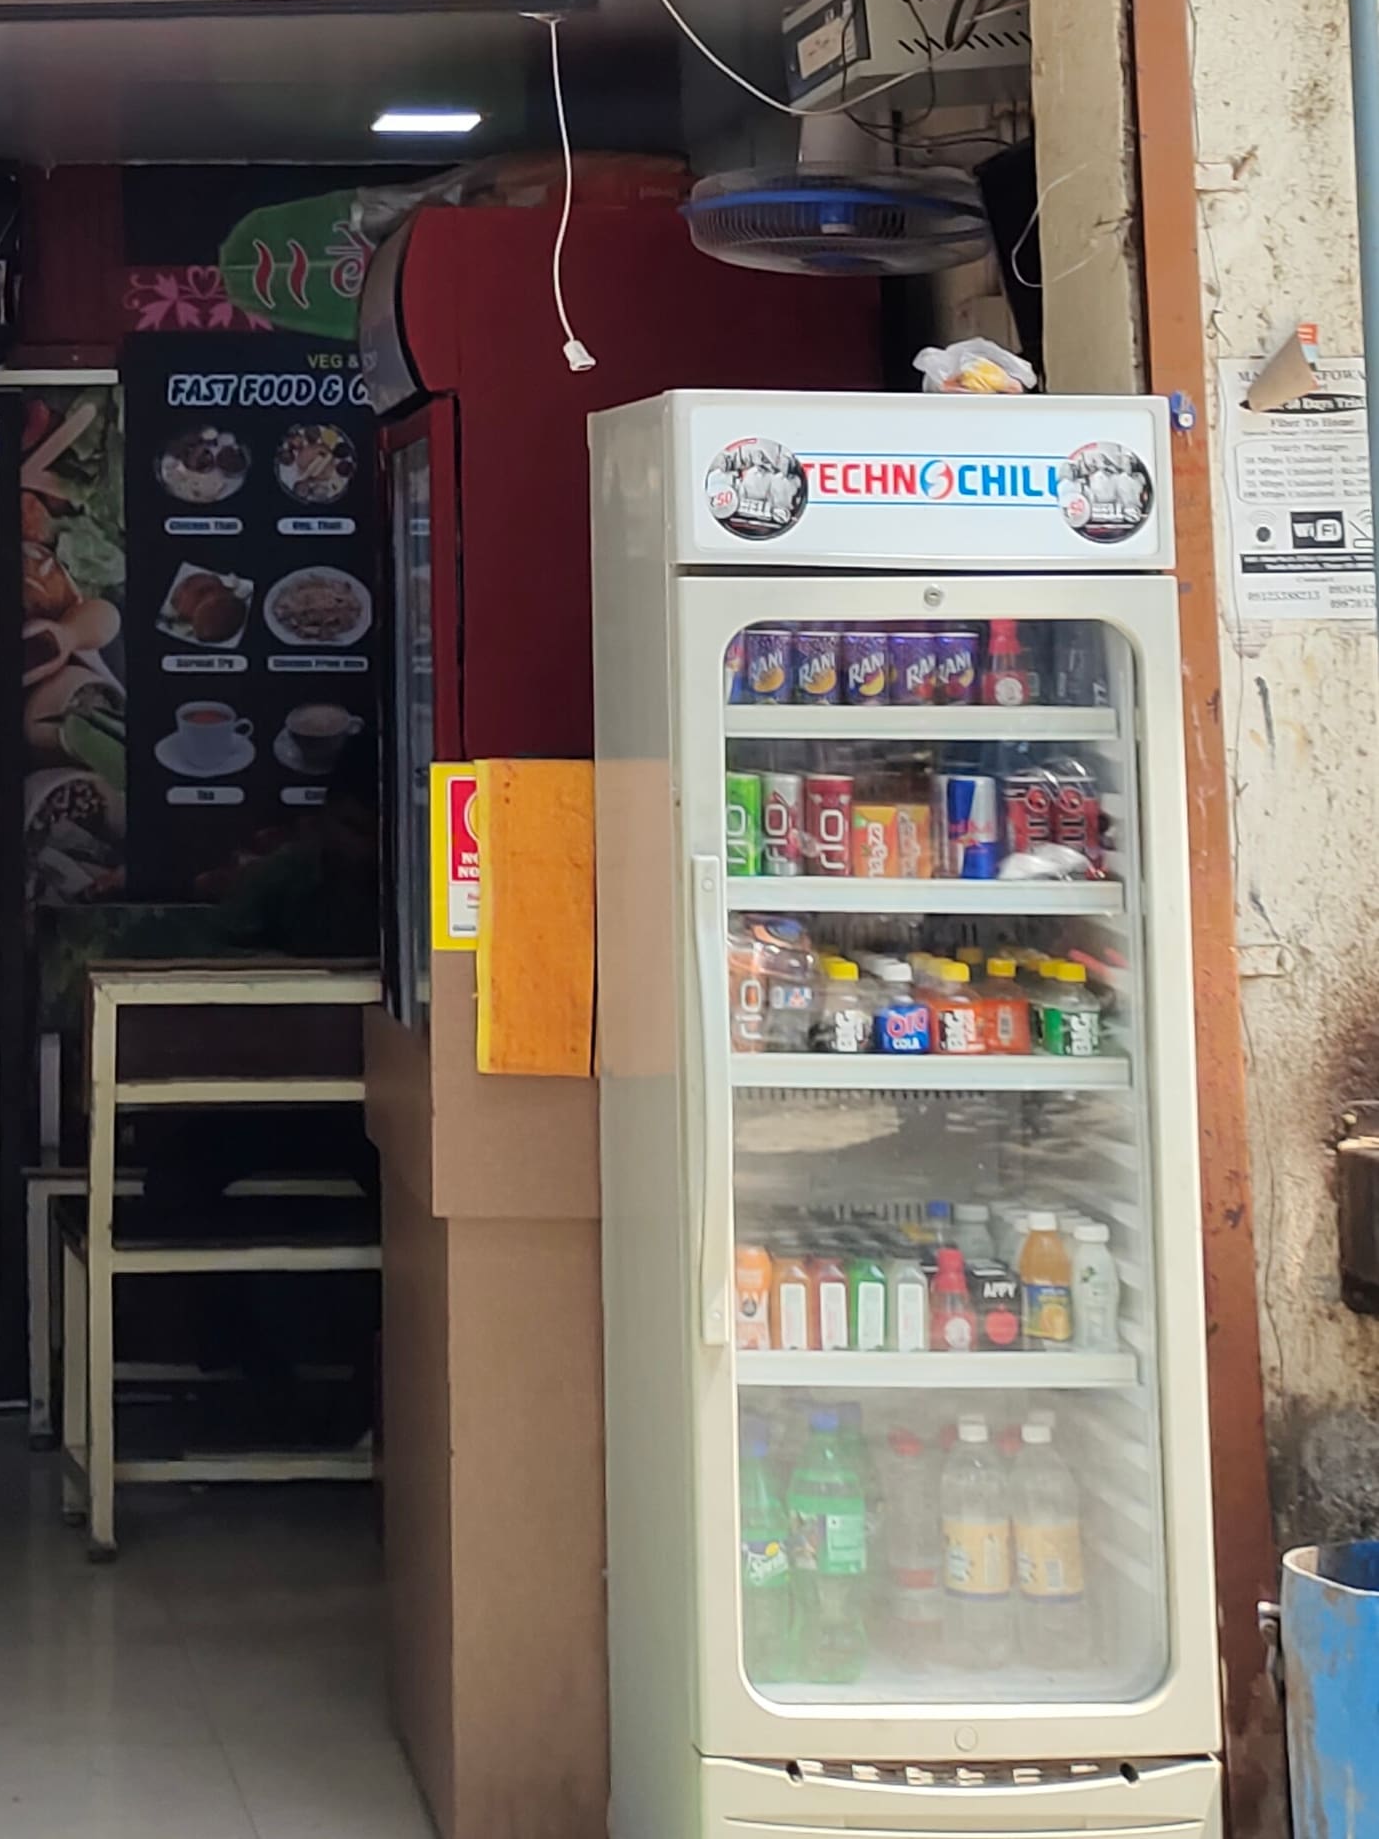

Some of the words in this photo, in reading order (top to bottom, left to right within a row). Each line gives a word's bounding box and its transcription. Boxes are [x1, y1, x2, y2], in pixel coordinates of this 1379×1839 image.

[307, 354, 343, 369] VEG
[168, 374, 238, 406] FAST
[238, 374, 316, 406] FOOD
[319, 374, 344, 406] &
[798, 651, 836, 687] RANI
[848, 651, 886, 690] RANI
